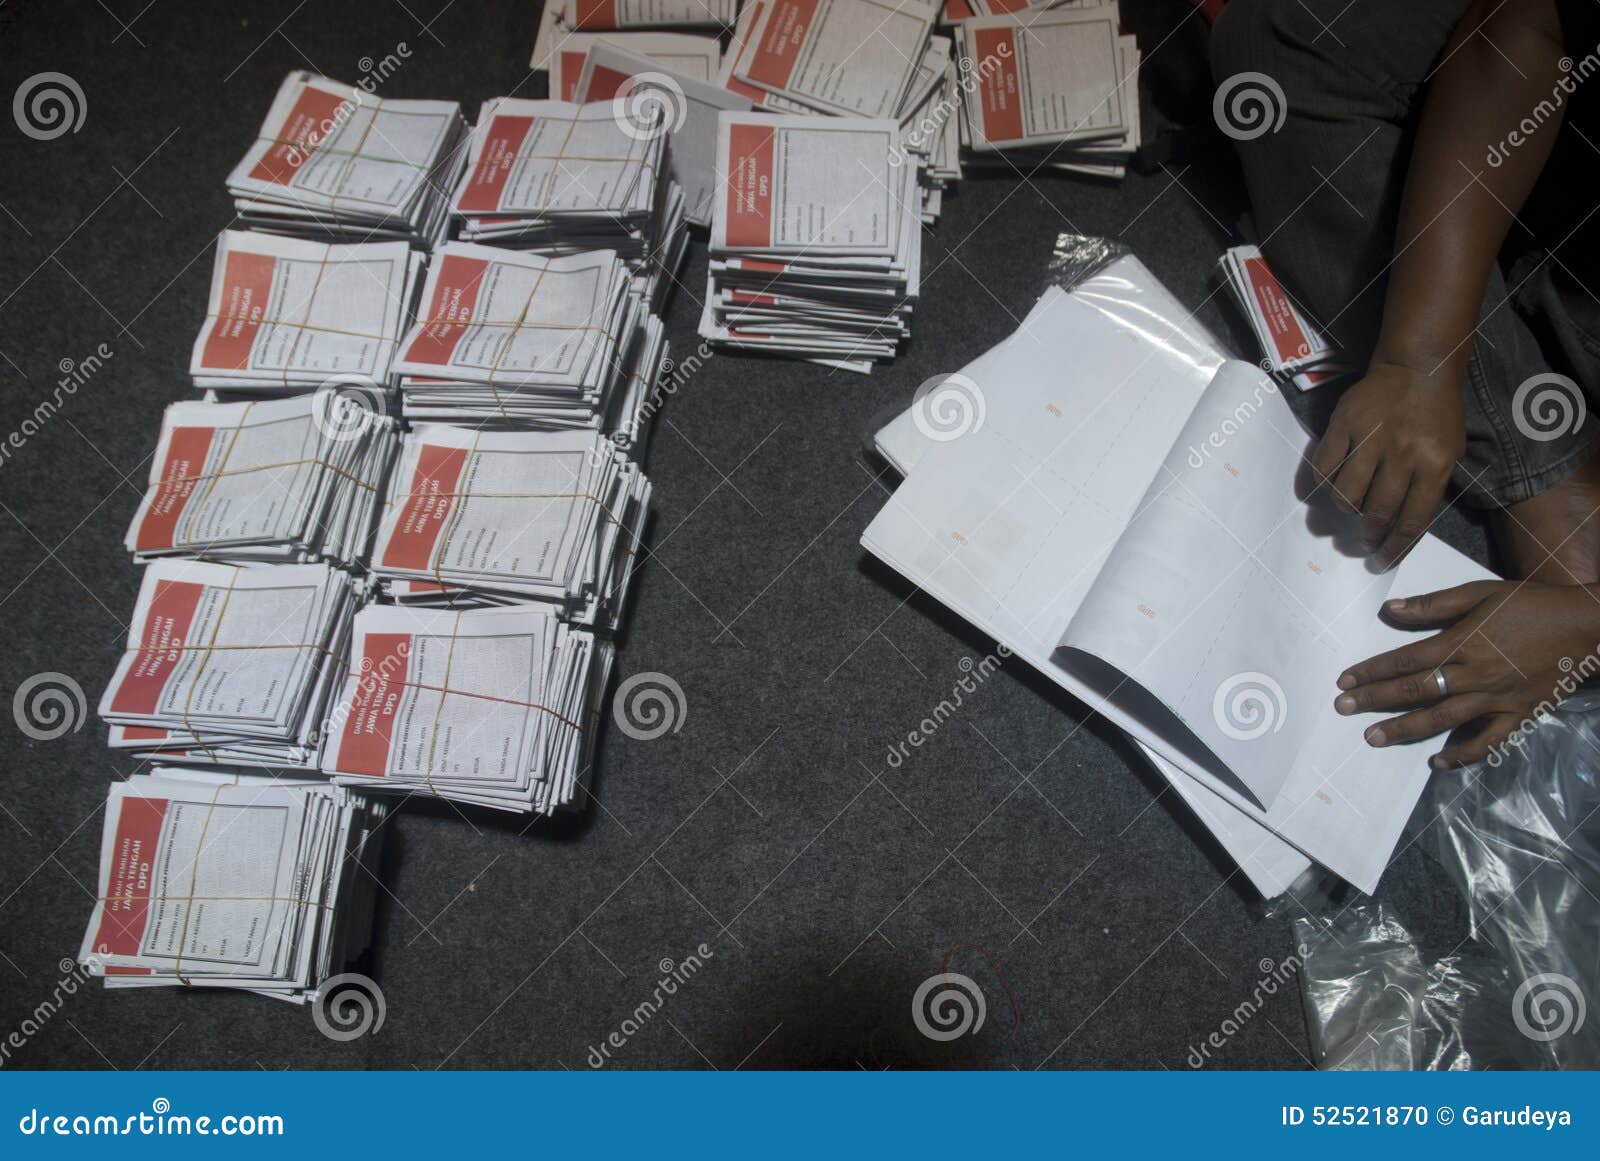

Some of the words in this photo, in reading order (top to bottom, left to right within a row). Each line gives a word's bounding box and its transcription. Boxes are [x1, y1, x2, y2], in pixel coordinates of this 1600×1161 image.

[759, 175, 768, 196] DPD
[433, 499, 447, 519] DPD
[415, 513, 429, 533] JAWA
[147, 655, 165, 676] JAWA
[382, 693, 397, 715] DPD
[353, 707, 367, 735] DAERAH
[365, 710, 379, 733] JAWA
[117, 838, 130, 878] PEMILIHAN
[126, 840, 142, 879] TENGAH
[137, 863, 149, 889] DPD
